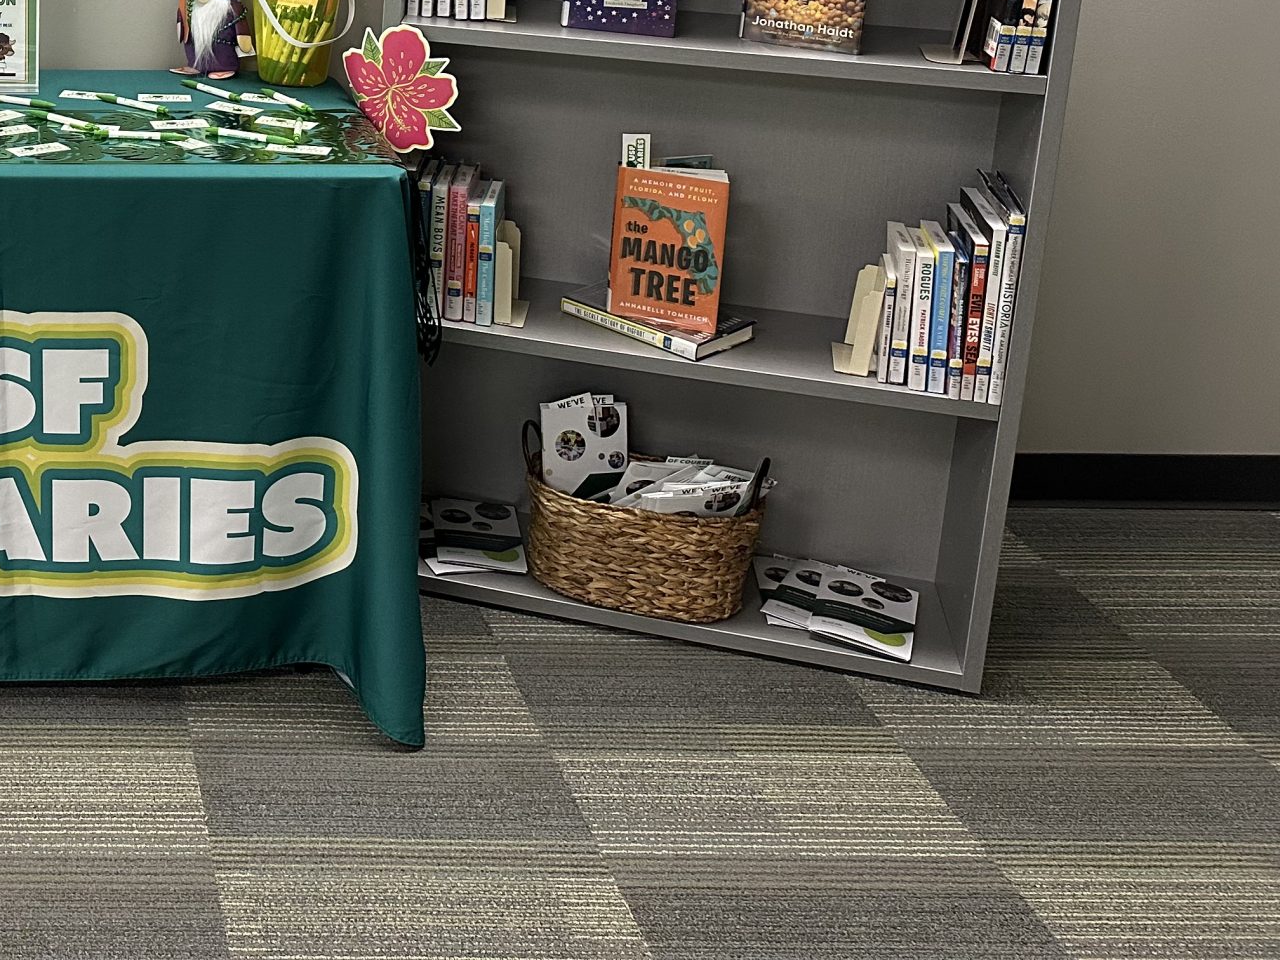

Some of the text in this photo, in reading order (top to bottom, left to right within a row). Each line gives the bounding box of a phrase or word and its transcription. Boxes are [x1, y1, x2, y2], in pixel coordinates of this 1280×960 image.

[752, 15, 855, 39] Jonathan Haidt
[629, 185, 665, 196] FLORIDA,
[688, 194, 718, 204] FELONY
[641, 179, 673, 188] MEMOIR
[689, 186, 716, 196] FRUIT,
[433, 196, 445, 255] MEAN BOYS
[627, 221, 648, 234] the
[621, 236, 709, 273] MANGO
[629, 267, 697, 307] TREE
[920, 263, 932, 301] ROGUES
[620, 301, 708, 323] ANNABELLE TOMETICH
[1000, 282, 1015, 329] HISTORIA
[964, 293, 982, 365] EVIL EYES SEA
[557, 397, 585, 409] WE'VE
